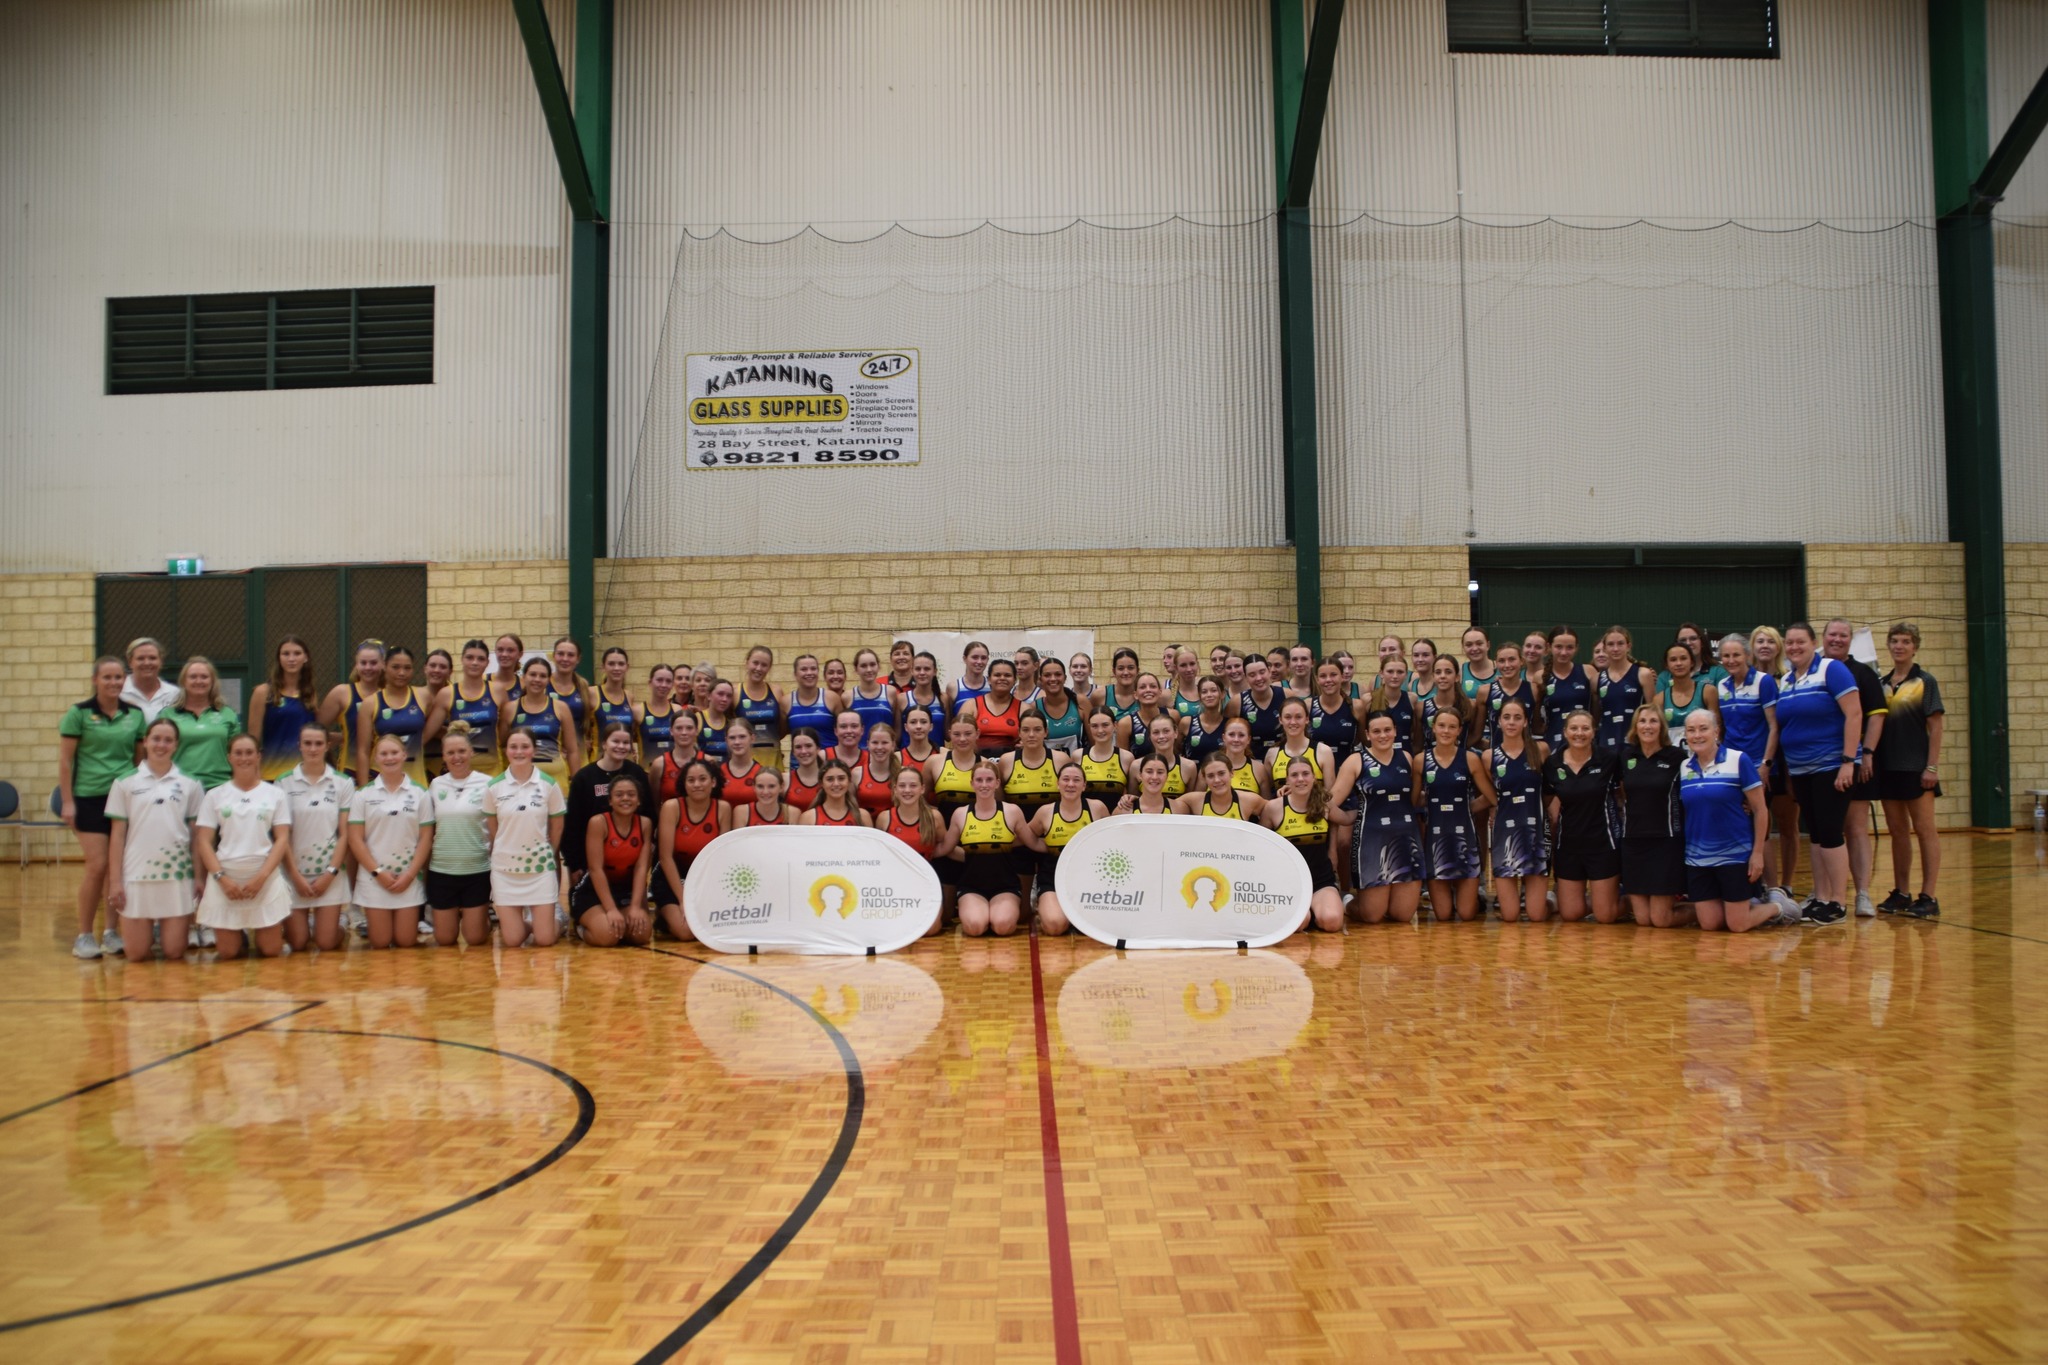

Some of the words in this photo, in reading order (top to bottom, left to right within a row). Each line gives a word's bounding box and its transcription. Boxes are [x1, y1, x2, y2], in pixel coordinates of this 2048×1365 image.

[709, 354, 748, 362] Friendly,
[752, 353, 785, 361] Prompt
[868, 357, 902, 374] 24/7
[705, 363, 833, 396] KATANNING
[694, 401, 751, 419] GLASS
[759, 399, 842, 418] SUPPLIES
[698, 440, 716, 449] 28
[722, 440, 751, 449] Bay
[757, 438, 811, 447] Street,
[817, 436, 903, 446] Katanning
[723, 451, 799, 464] 9821
[814, 449, 900, 462] 8590
[1180, 851, 1218, 859] PRINCIPAL
[1221, 853, 1255, 861] PARTNER
[861, 887, 893, 897] GOLD
[1234, 881, 1266, 893] GOLD
[861, 898, 921, 908] INDUSTRY
[1080, 890, 1144, 905] netball
[1234, 893, 1294, 905] INDUSTRY
[709, 902, 772, 922] netball
[861, 909, 903, 920] GROUP
[1233, 903, 1276, 915] GROUP
